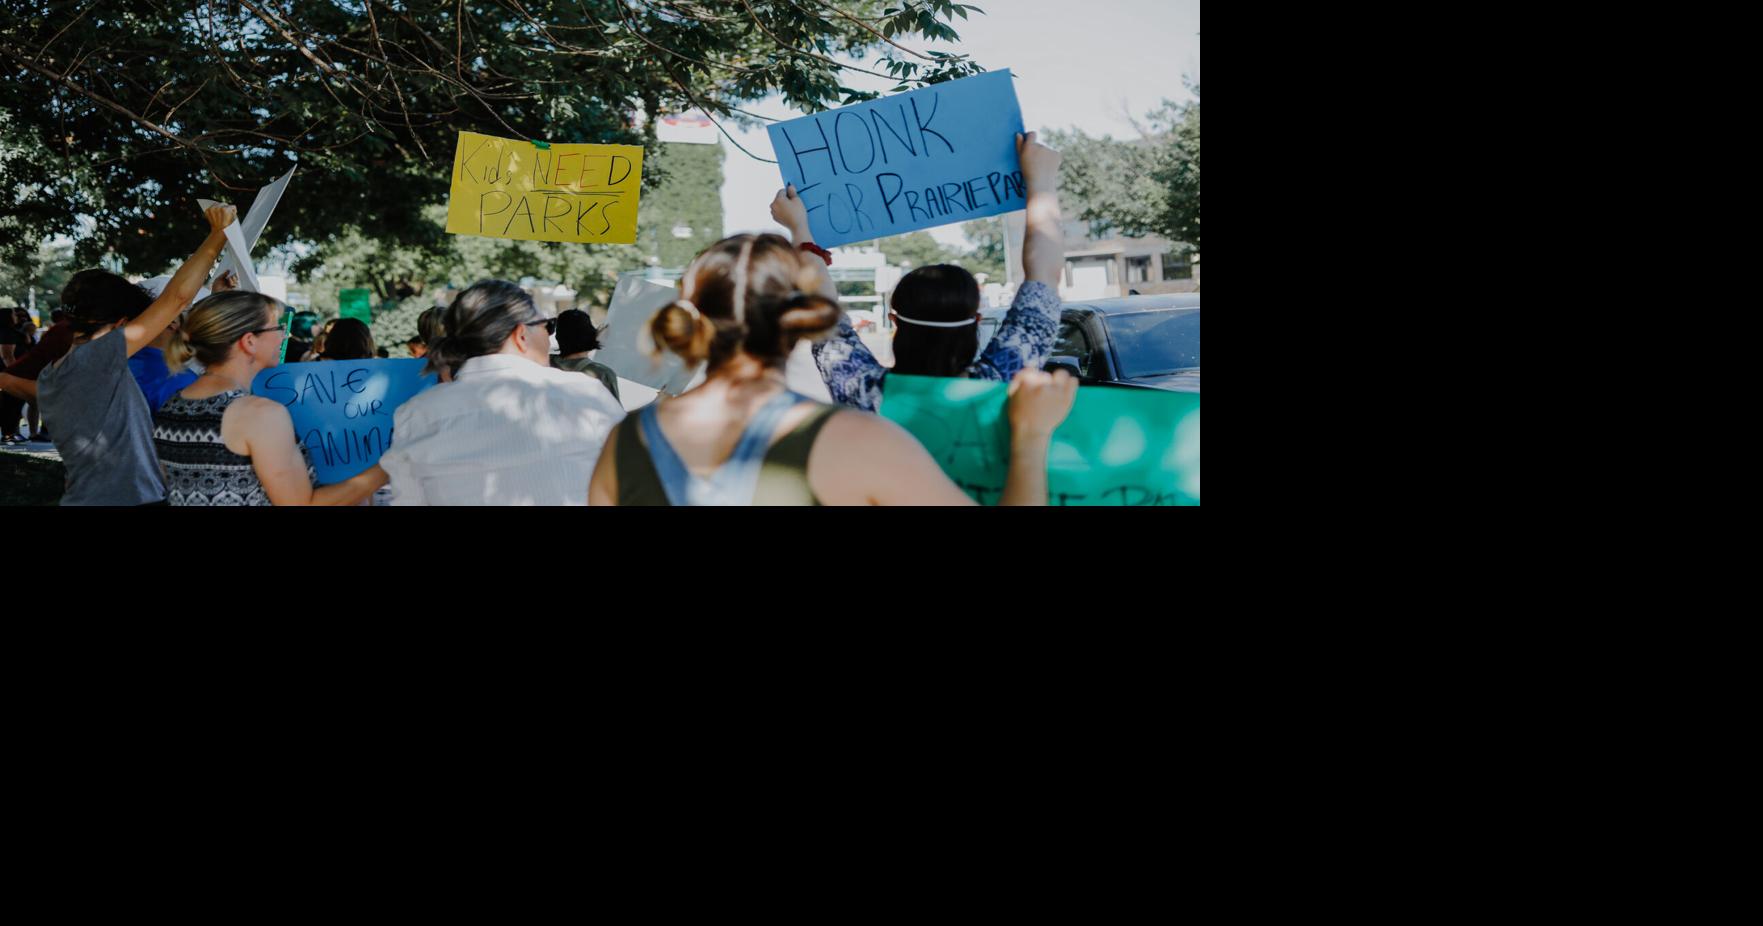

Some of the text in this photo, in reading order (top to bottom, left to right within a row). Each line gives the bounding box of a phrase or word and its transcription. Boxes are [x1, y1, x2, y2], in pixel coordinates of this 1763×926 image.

[782, 92, 955, 184] HONK
[460, 134, 632, 191] Kids NEED
[479, 190, 619, 235] PARKS
[264, 367, 370, 407] SAVE
[343, 399, 389, 419] OUR
